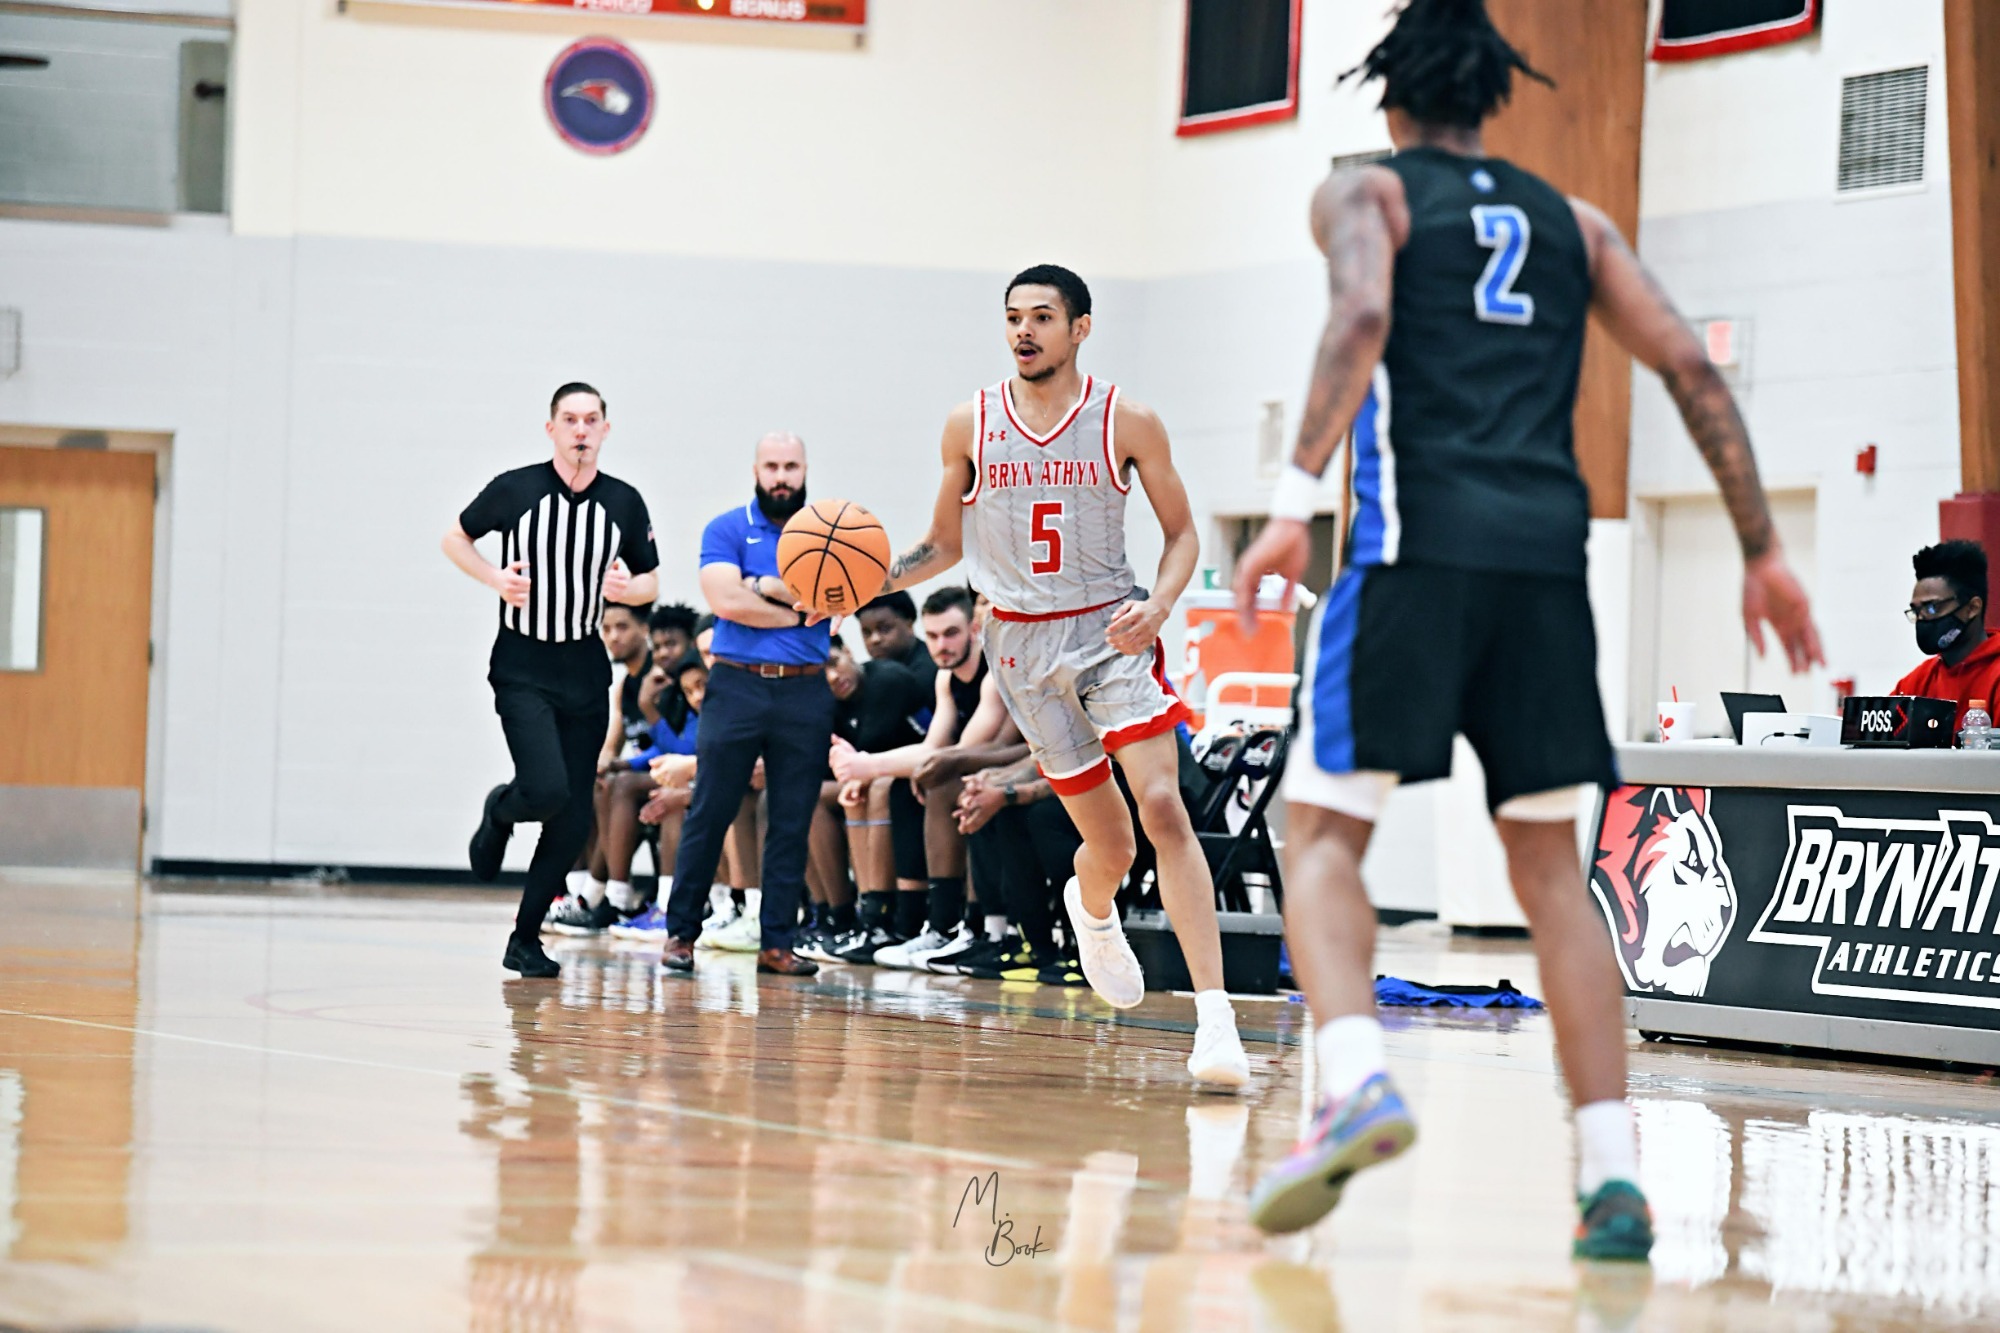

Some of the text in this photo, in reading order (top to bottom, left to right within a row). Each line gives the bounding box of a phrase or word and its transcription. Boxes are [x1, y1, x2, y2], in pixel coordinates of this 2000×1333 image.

[1470, 204, 1535, 326] 2
[988, 460, 1100, 489] BRYN ATHYN
[1030, 501, 1065, 575] 5
[1860, 709, 1894, 733] POSS.
